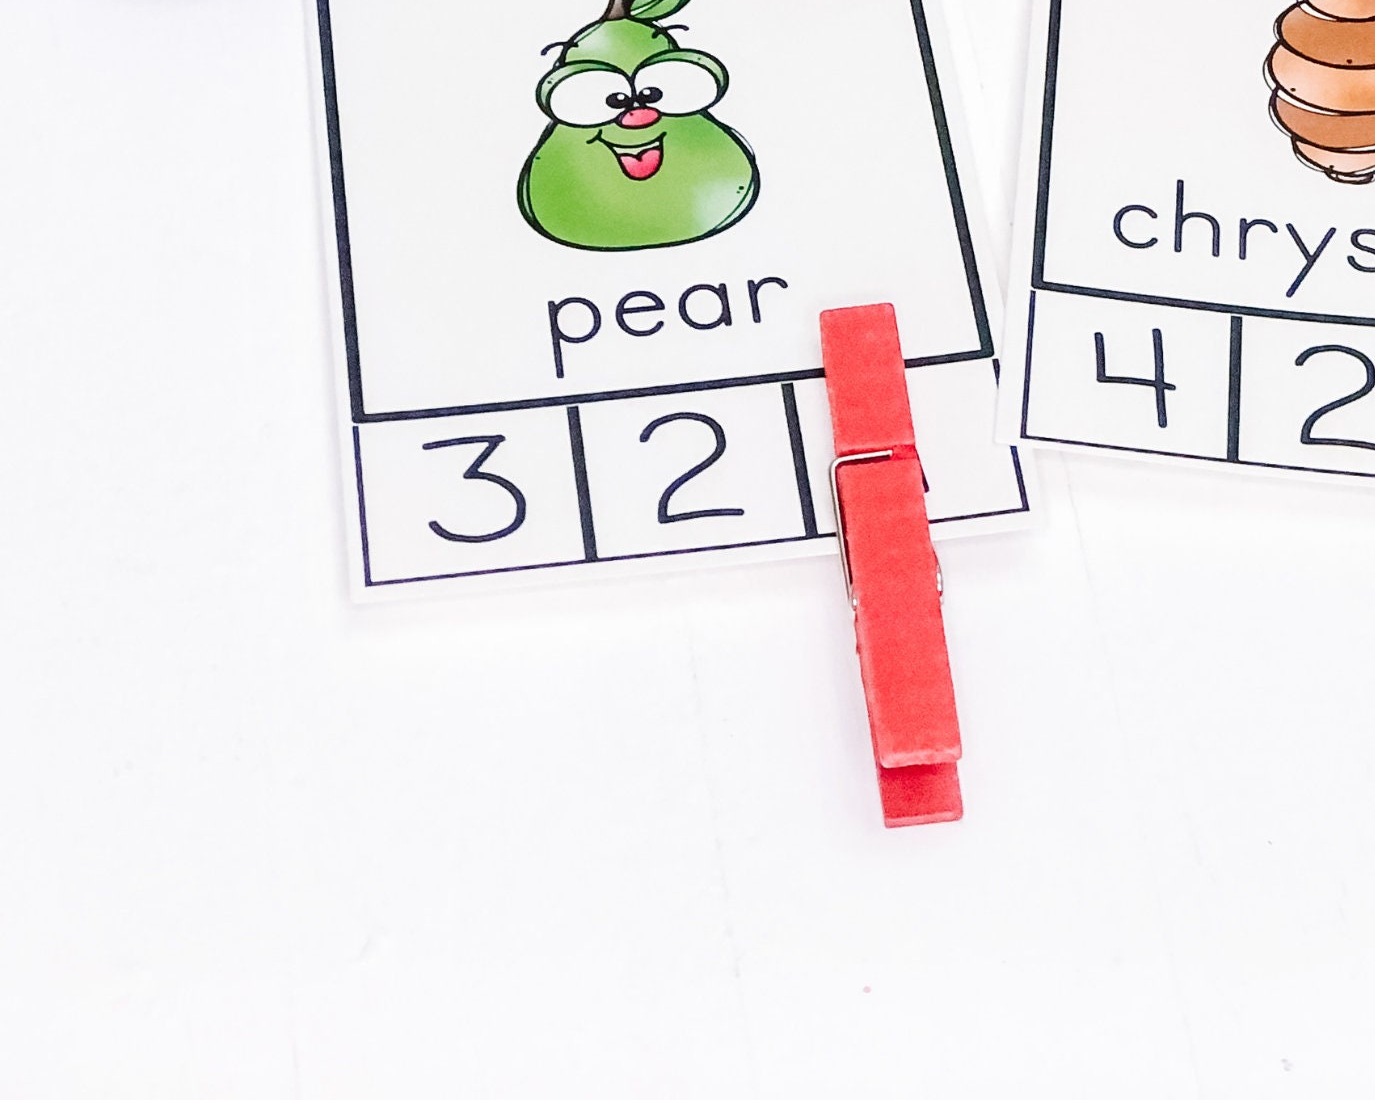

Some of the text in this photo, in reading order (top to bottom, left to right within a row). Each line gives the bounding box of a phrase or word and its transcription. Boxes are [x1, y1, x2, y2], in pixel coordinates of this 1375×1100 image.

[547, 275, 789, 379] pear
[1093, 328, 1177, 429] 4
[421, 411, 745, 544] 3 2
